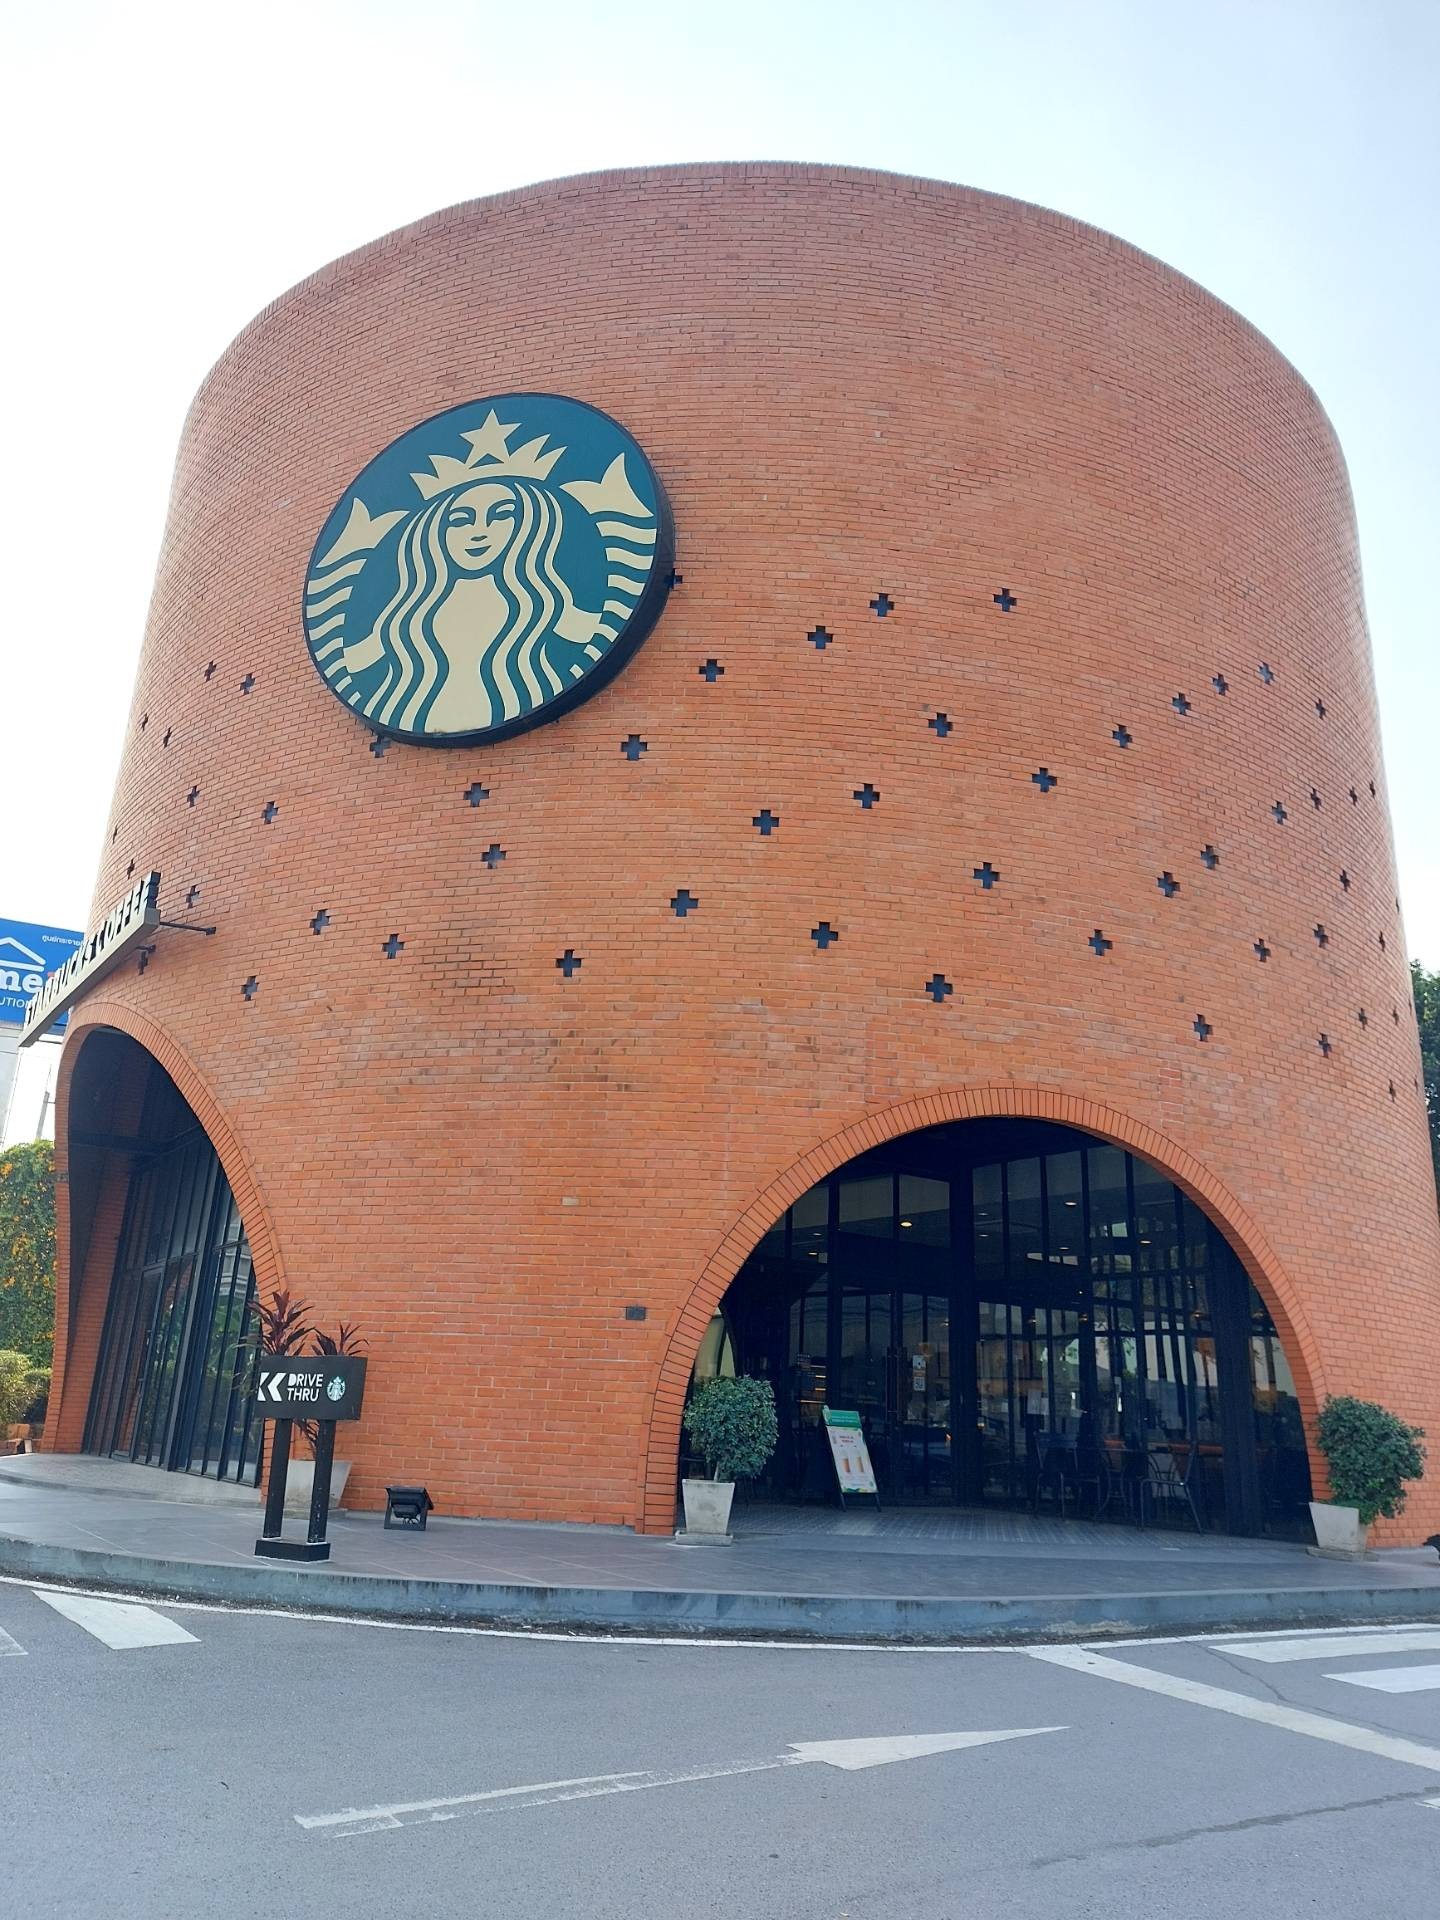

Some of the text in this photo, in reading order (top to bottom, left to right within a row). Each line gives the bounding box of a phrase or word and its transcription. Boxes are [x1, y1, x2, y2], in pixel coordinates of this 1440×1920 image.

[97, 871, 161, 952] COFFEE
[288, 1373, 324, 1387] DRIVE
[287, 1387, 320, 1402] THRU
